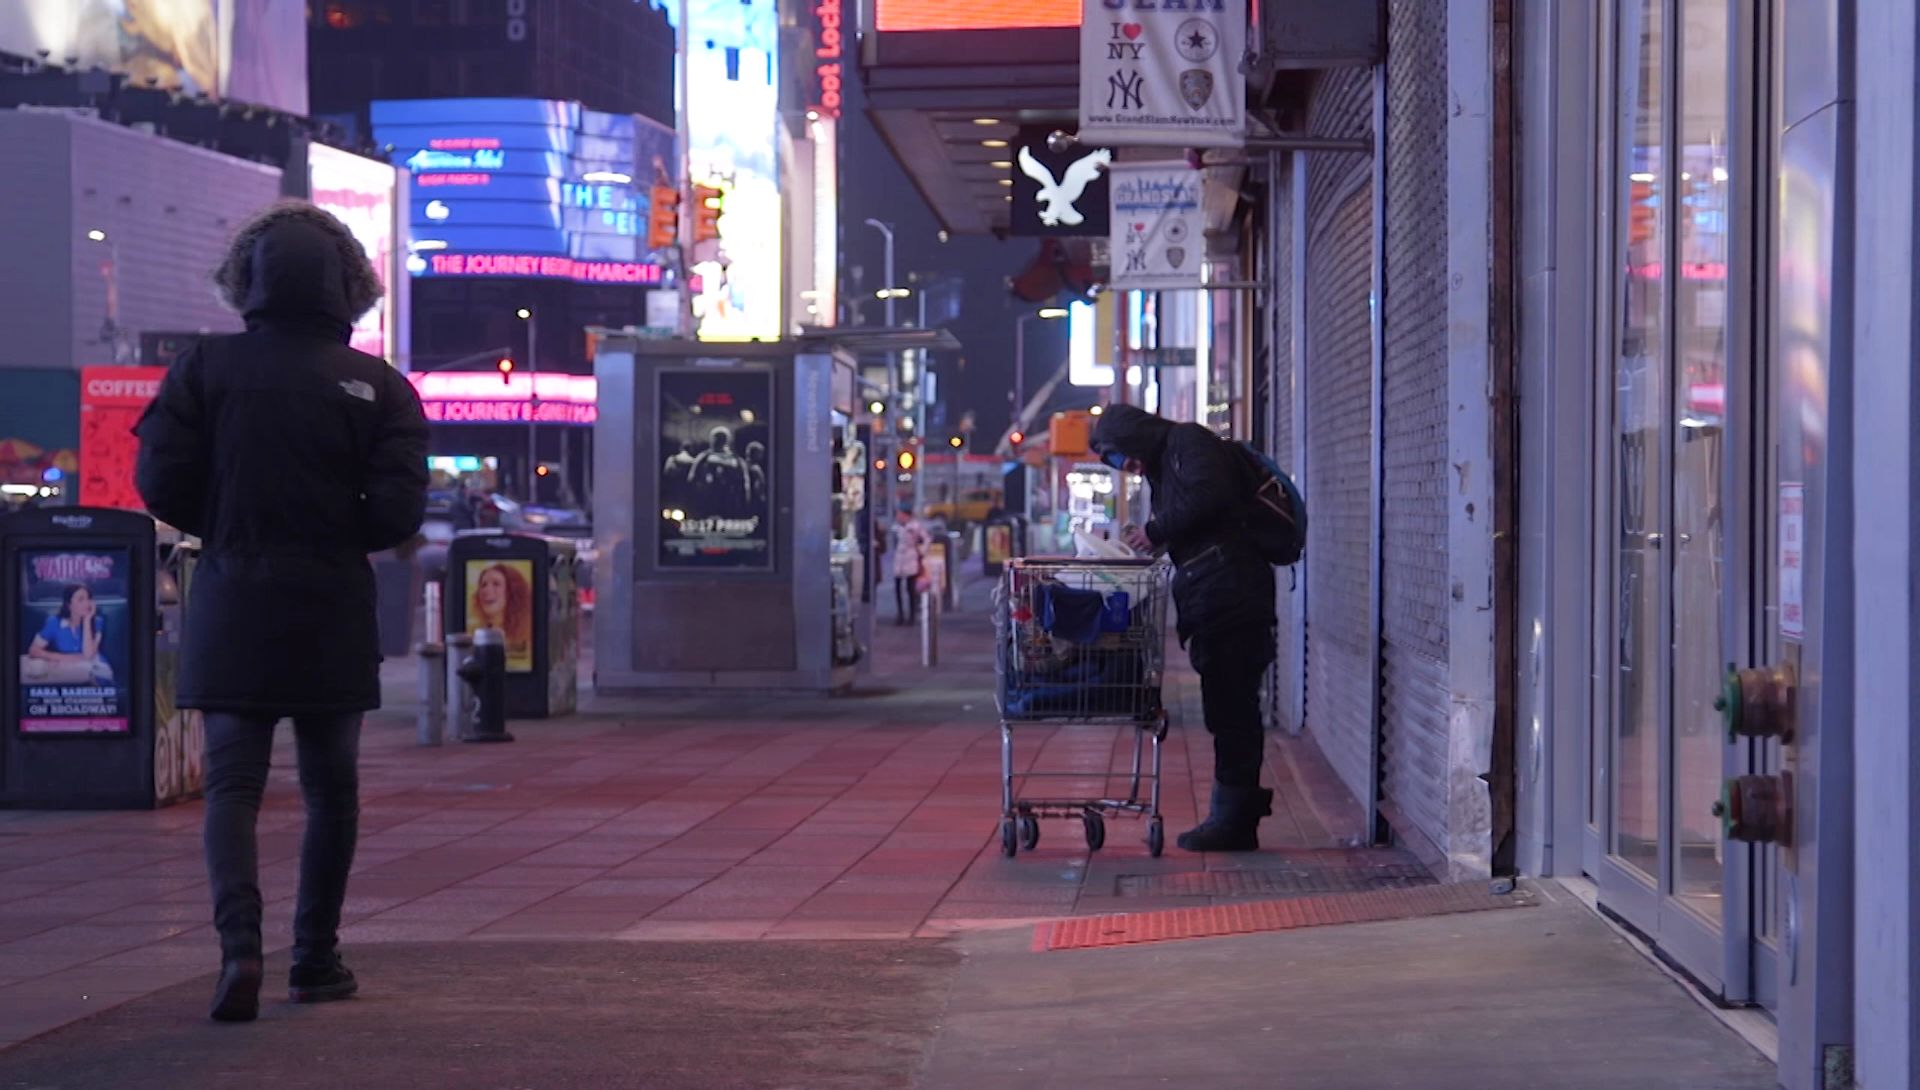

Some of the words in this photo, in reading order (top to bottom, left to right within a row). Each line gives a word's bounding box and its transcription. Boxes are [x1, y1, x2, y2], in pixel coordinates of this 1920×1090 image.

[1107, 43, 1145, 60] NY
[432, 254, 464, 275] THE
[465, 254, 541, 275] JOURNEY
[588, 262, 648, 283] MARCH
[445, 402, 521, 421] JOURNEY
[29, 704, 48, 715] ON
